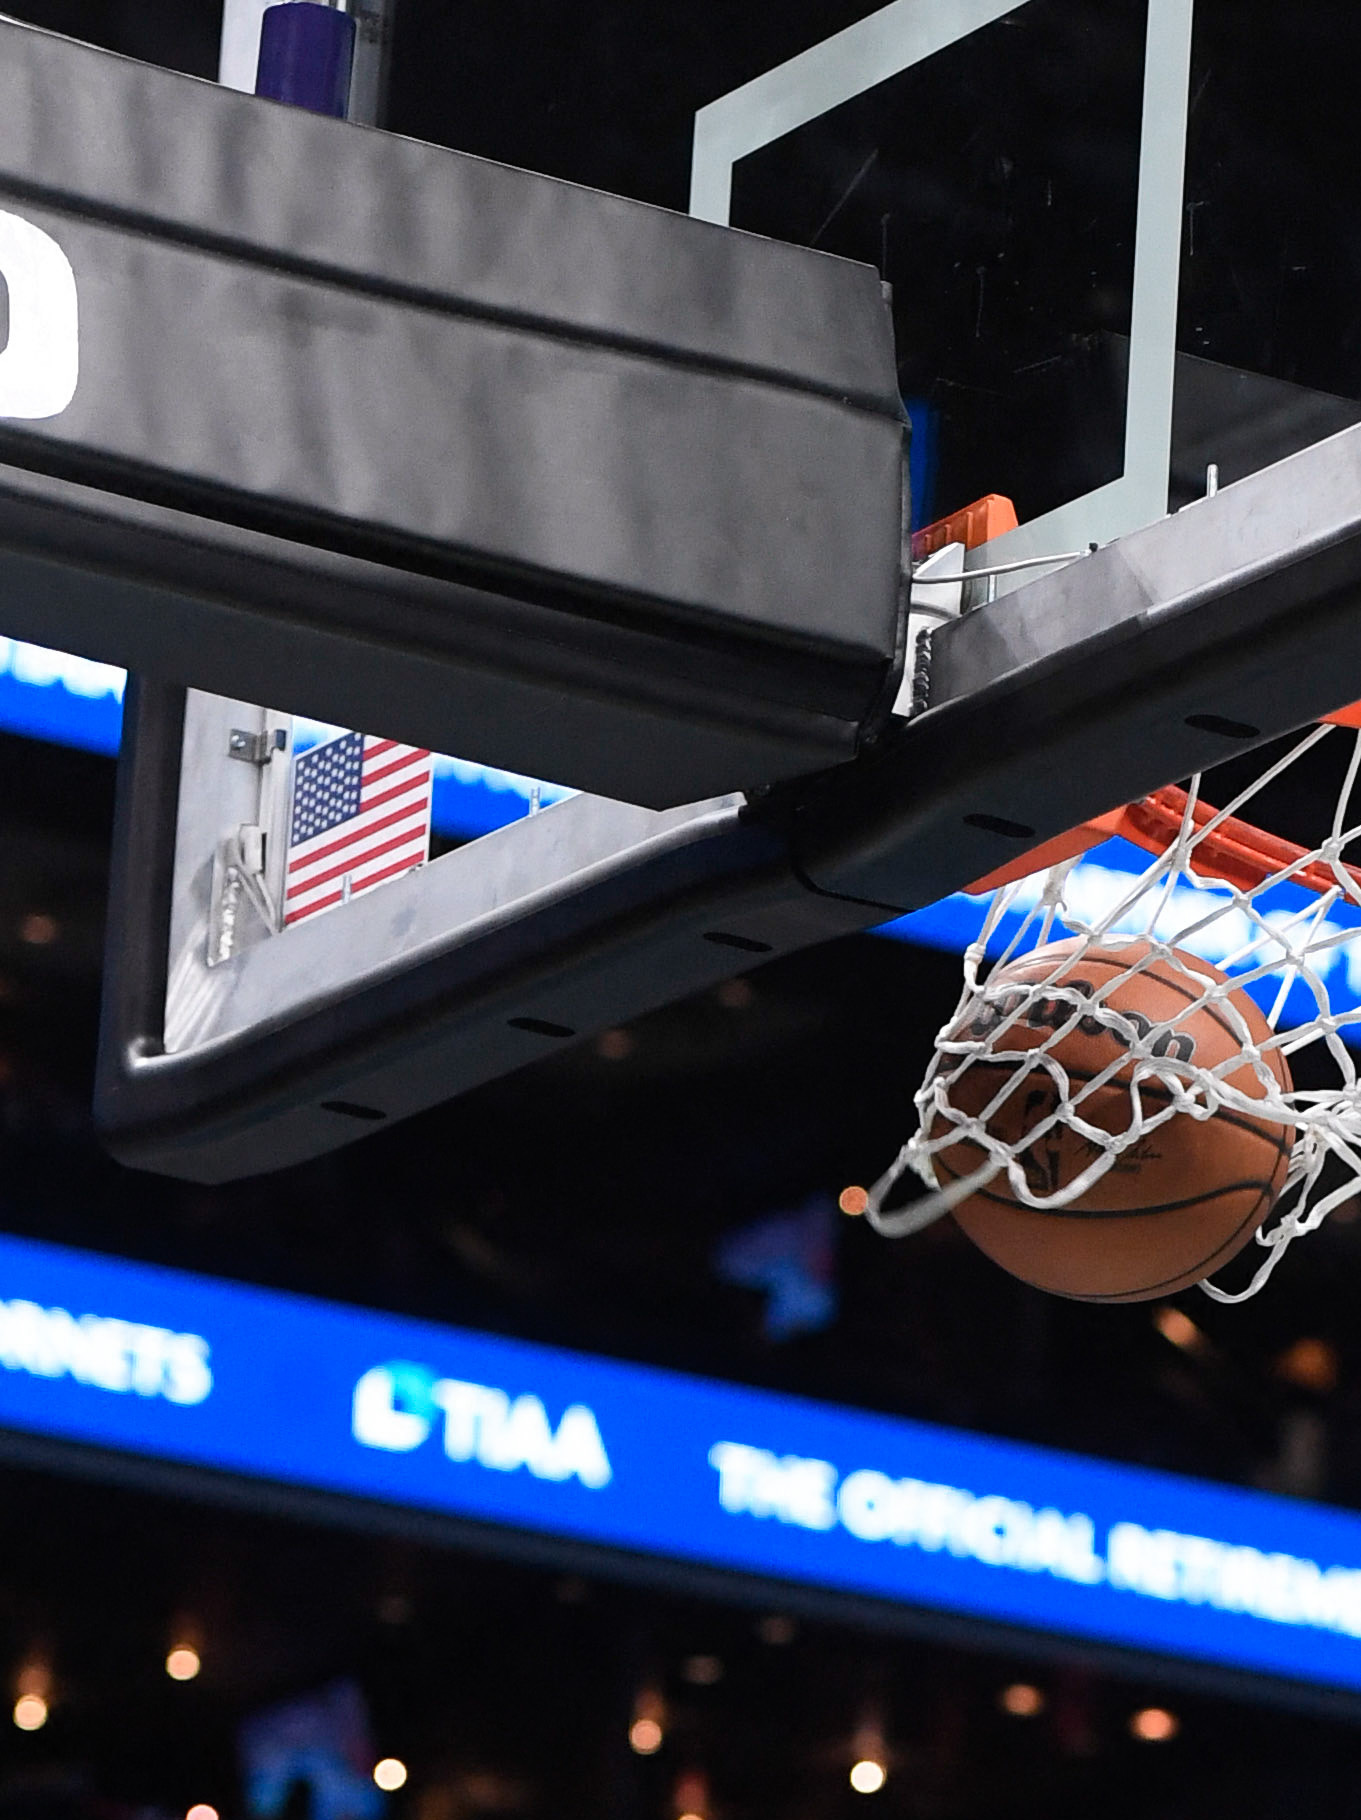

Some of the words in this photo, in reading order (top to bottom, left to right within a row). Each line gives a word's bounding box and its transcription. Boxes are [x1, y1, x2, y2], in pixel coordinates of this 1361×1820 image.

[0, 1299, 212, 1406] RNETS
[432, 1379, 612, 1488] TIAA
[710, 1442, 838, 1530] THE
